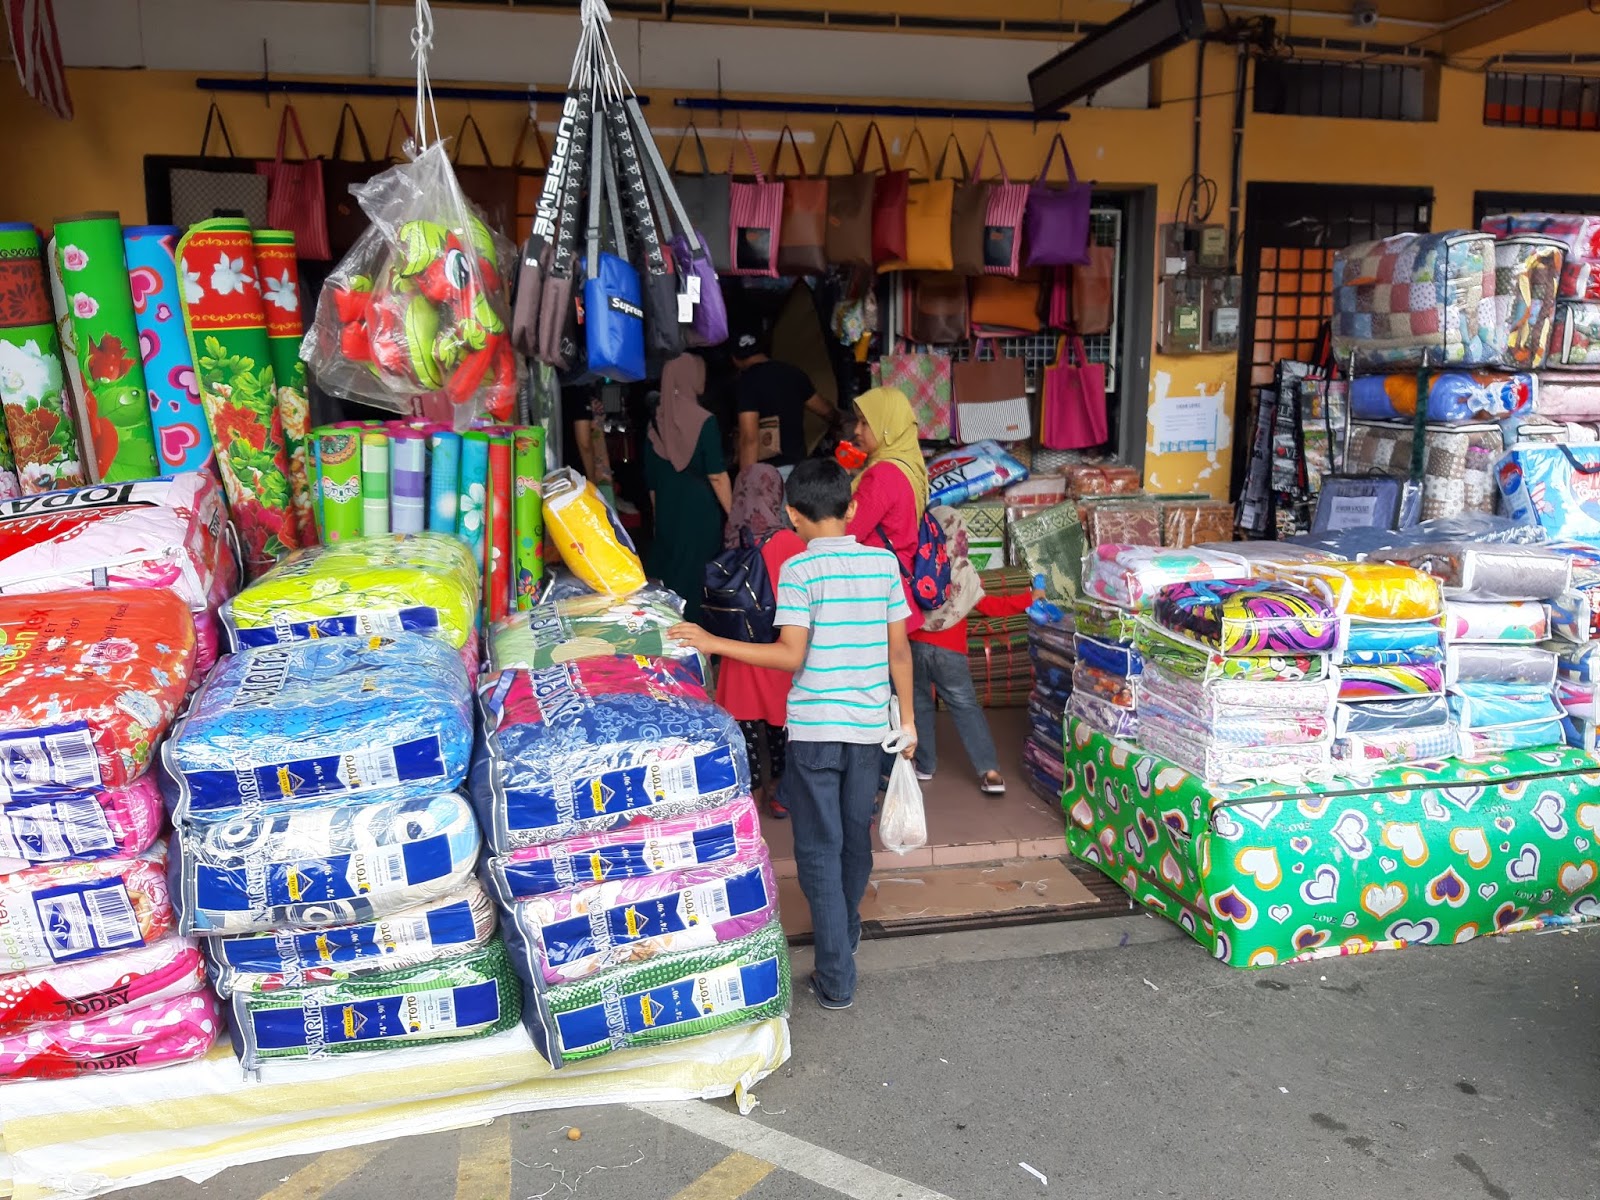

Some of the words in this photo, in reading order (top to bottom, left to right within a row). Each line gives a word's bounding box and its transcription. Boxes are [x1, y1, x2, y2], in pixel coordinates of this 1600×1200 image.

[533, 96, 578, 236] SUPREME
[0, 484, 158, 519] TODA
[345, 754, 355, 780] TOTO
[622, 774, 631, 786] 90"
[651, 765, 661, 790] TOTO
[234, 750, 261, 821] NARITA
[626, 794, 636, 808] 74"
[650, 840, 659, 863] TOTO
[354, 853, 365, 882] TOTO
[246, 845, 273, 923] NARITA
[326, 886, 335, 899] 74"
[656, 900, 665, 911] 90"
[685, 889, 696, 917] TOTO
[589, 894, 617, 967] NARITA
[660, 920, 669, 933] 74"
[1313, 912, 1338, 925] LOVE
[97, 929, 107, 947] MADE
[276, 927, 301, 988] NARIT
[54, 984, 130, 1017] TODAY
[671, 987, 680, 998] 90"
[698, 977, 709, 1005] TOTO
[376, 1002, 385, 1013] 90"
[409, 995, 417, 1022] TOTO
[602, 982, 630, 1050] NARITA
[675, 1007, 683, 1020] 74"
[302, 991, 331, 1060] NARITA
[379, 1020, 388, 1036] 74"
